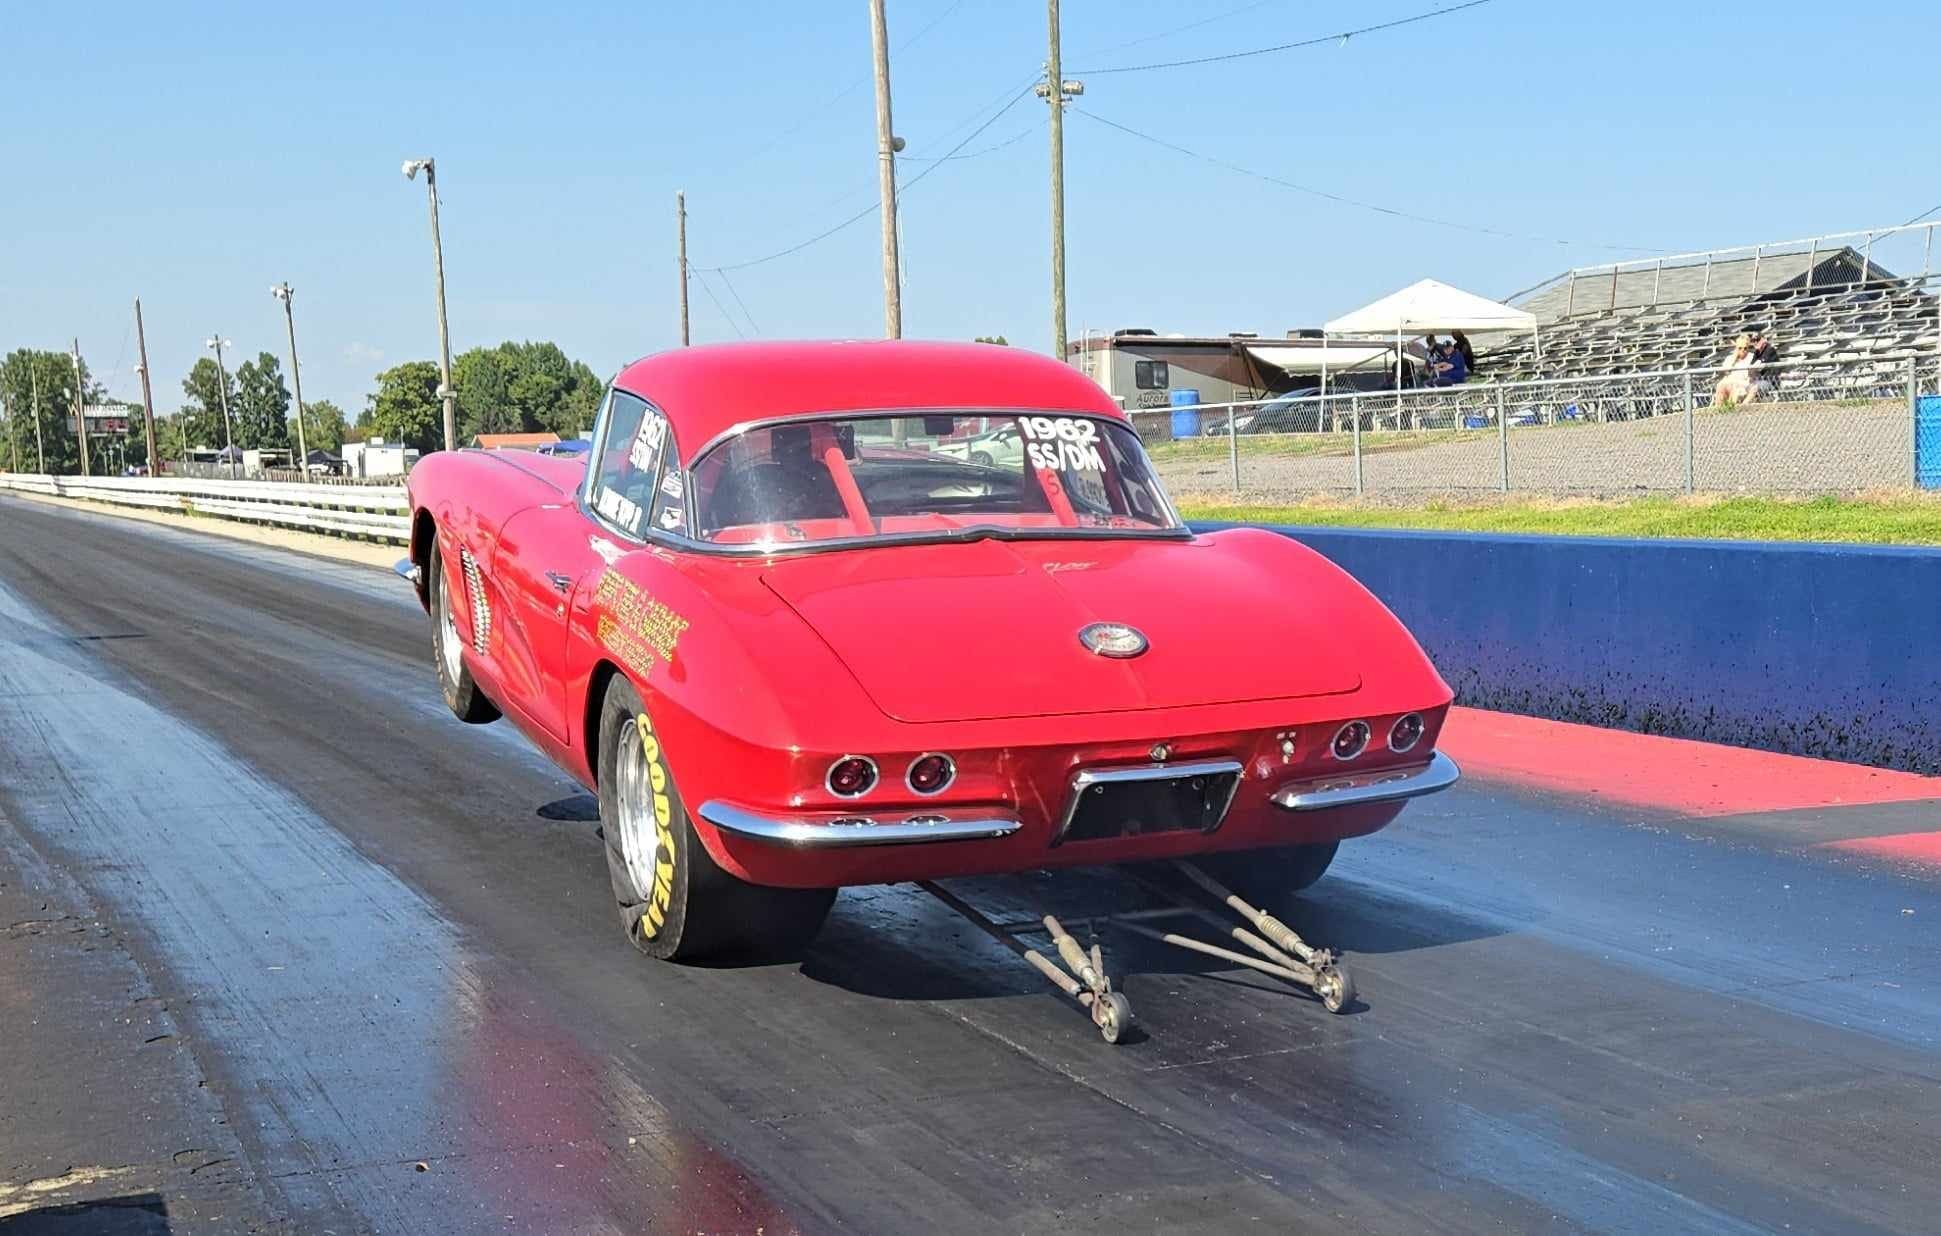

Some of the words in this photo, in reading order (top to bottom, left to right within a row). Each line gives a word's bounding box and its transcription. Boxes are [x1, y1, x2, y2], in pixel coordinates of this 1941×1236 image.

[1018, 416, 1100, 442] 1962
[1027, 440, 1106, 472] SS/DM
[637, 712, 676, 939] GOODYEAR
